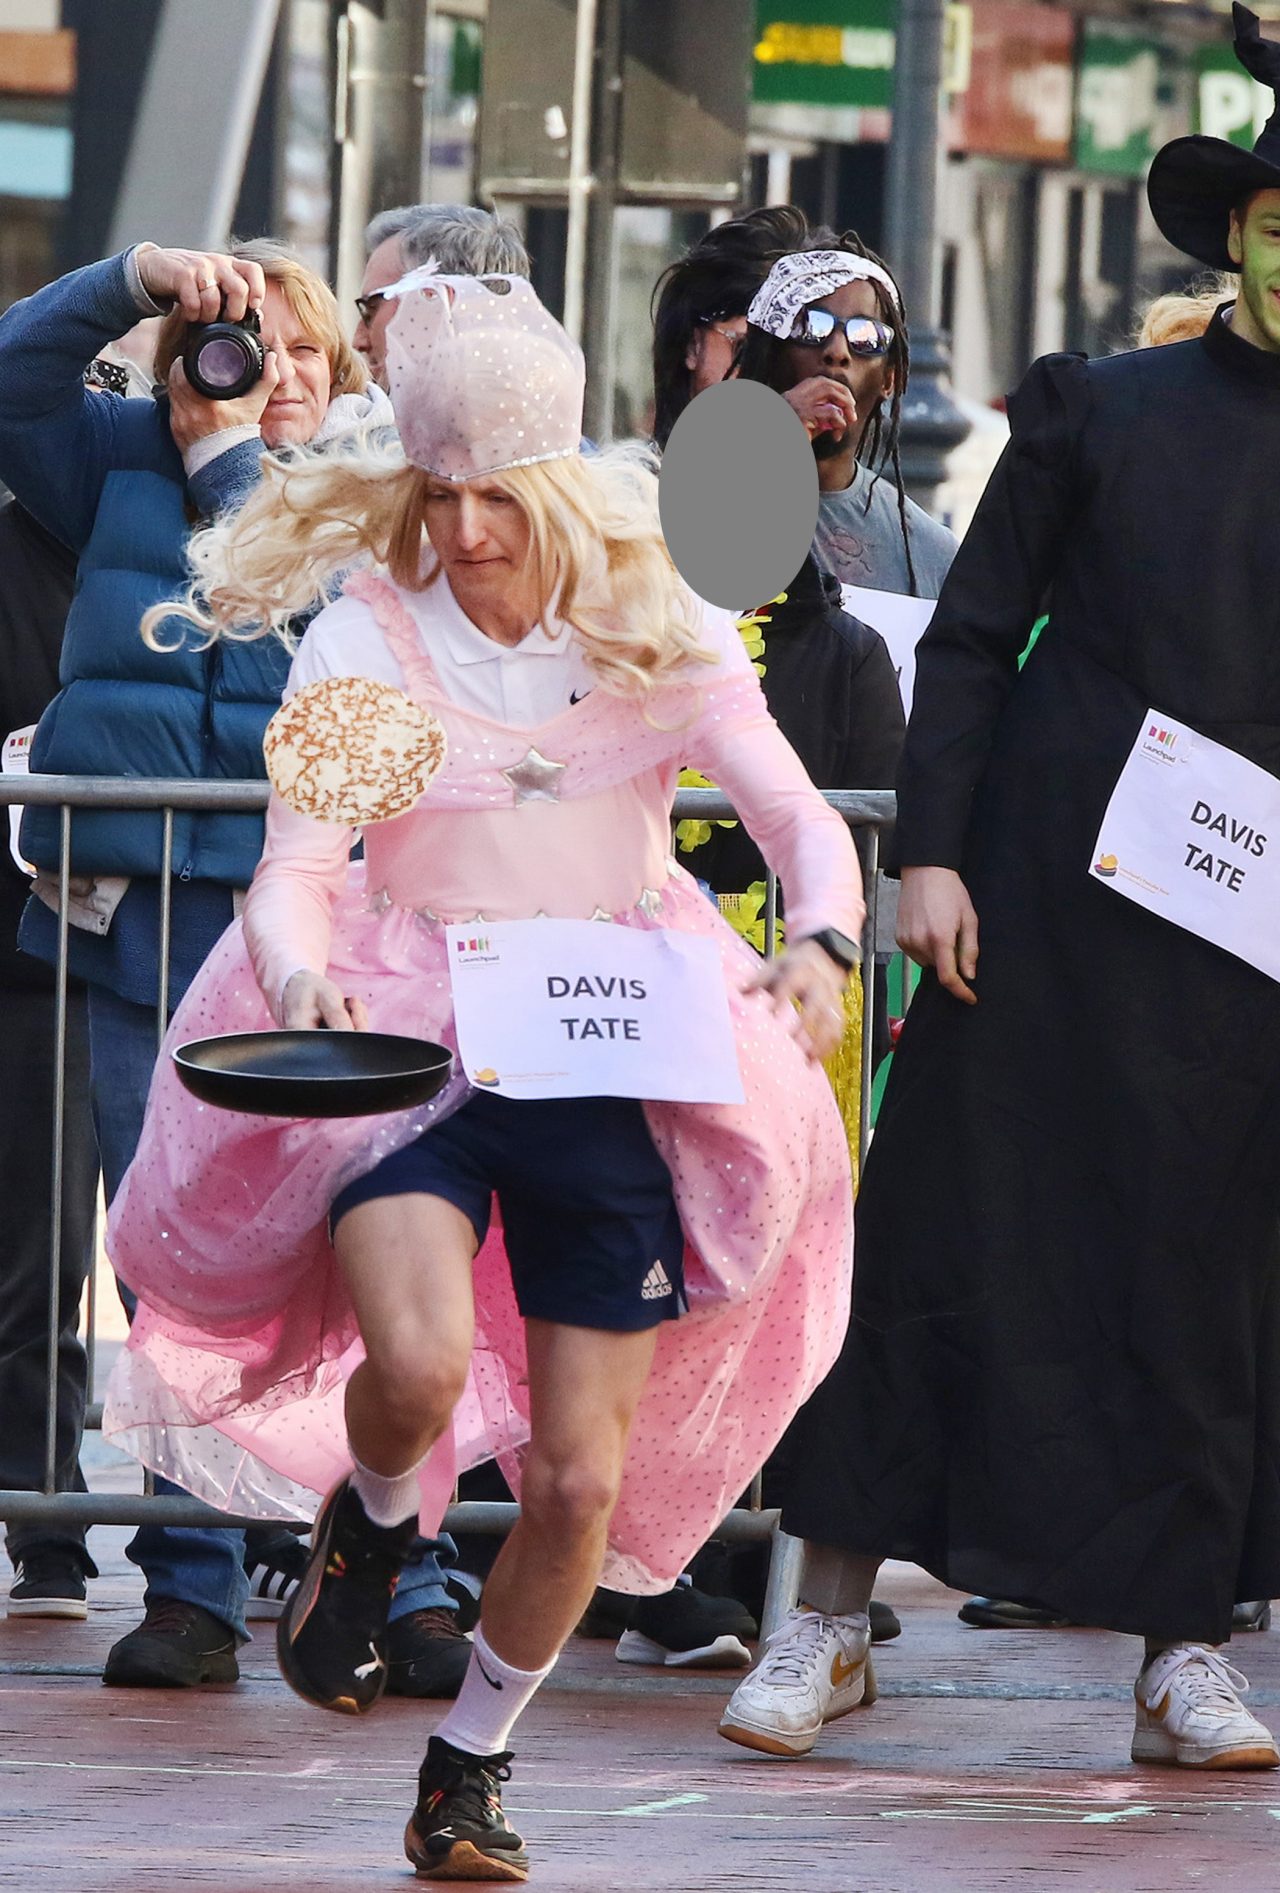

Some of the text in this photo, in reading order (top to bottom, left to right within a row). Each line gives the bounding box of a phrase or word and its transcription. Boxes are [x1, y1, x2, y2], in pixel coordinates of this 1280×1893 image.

[1190, 800, 1268, 857] DAVIS
[1184, 843, 1246, 893] TATE
[547, 976, 647, 1000] DAVIS
[560, 1018, 641, 1041] TATE
[641, 1282, 673, 1300] adidas
